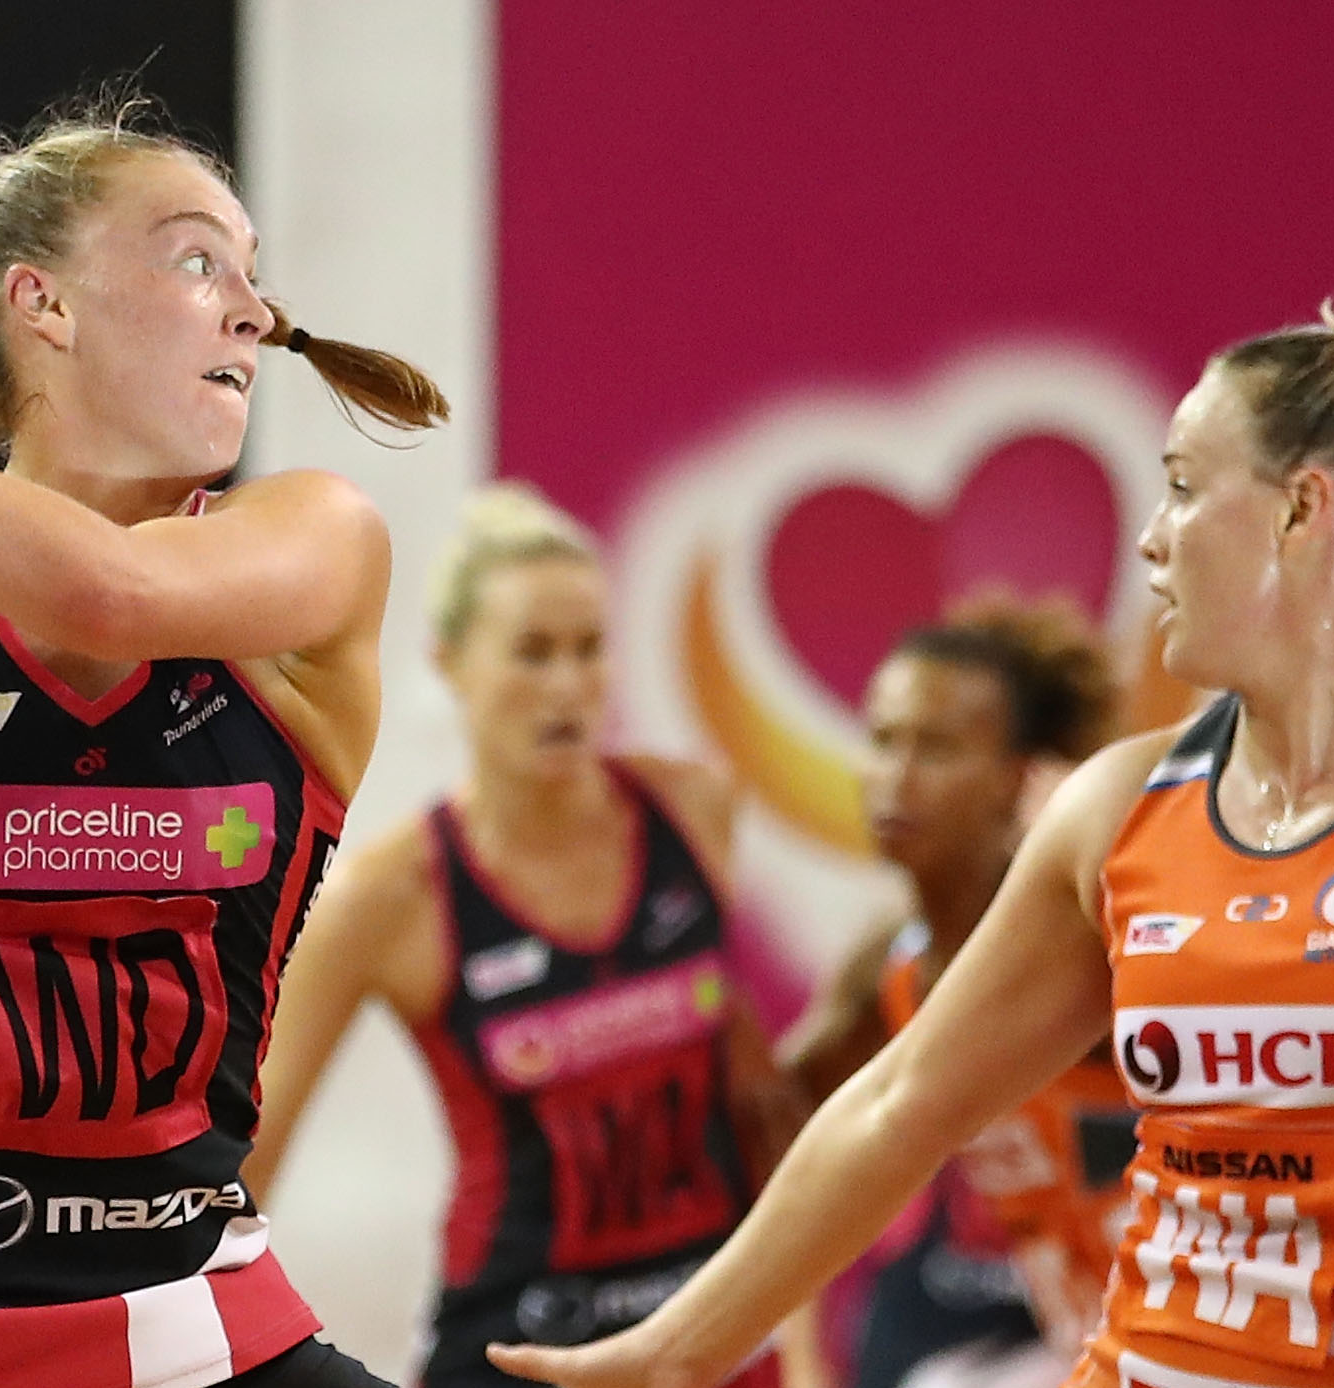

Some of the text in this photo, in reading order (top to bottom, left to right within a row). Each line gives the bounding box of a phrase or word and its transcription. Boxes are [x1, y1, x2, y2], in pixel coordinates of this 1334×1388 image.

[4, 803, 184, 841] priceline
[3, 845, 184, 880] pharmacy
[1163, 1145, 1314, 1183] NISSAN
[46, 1182, 246, 1234] mazda
